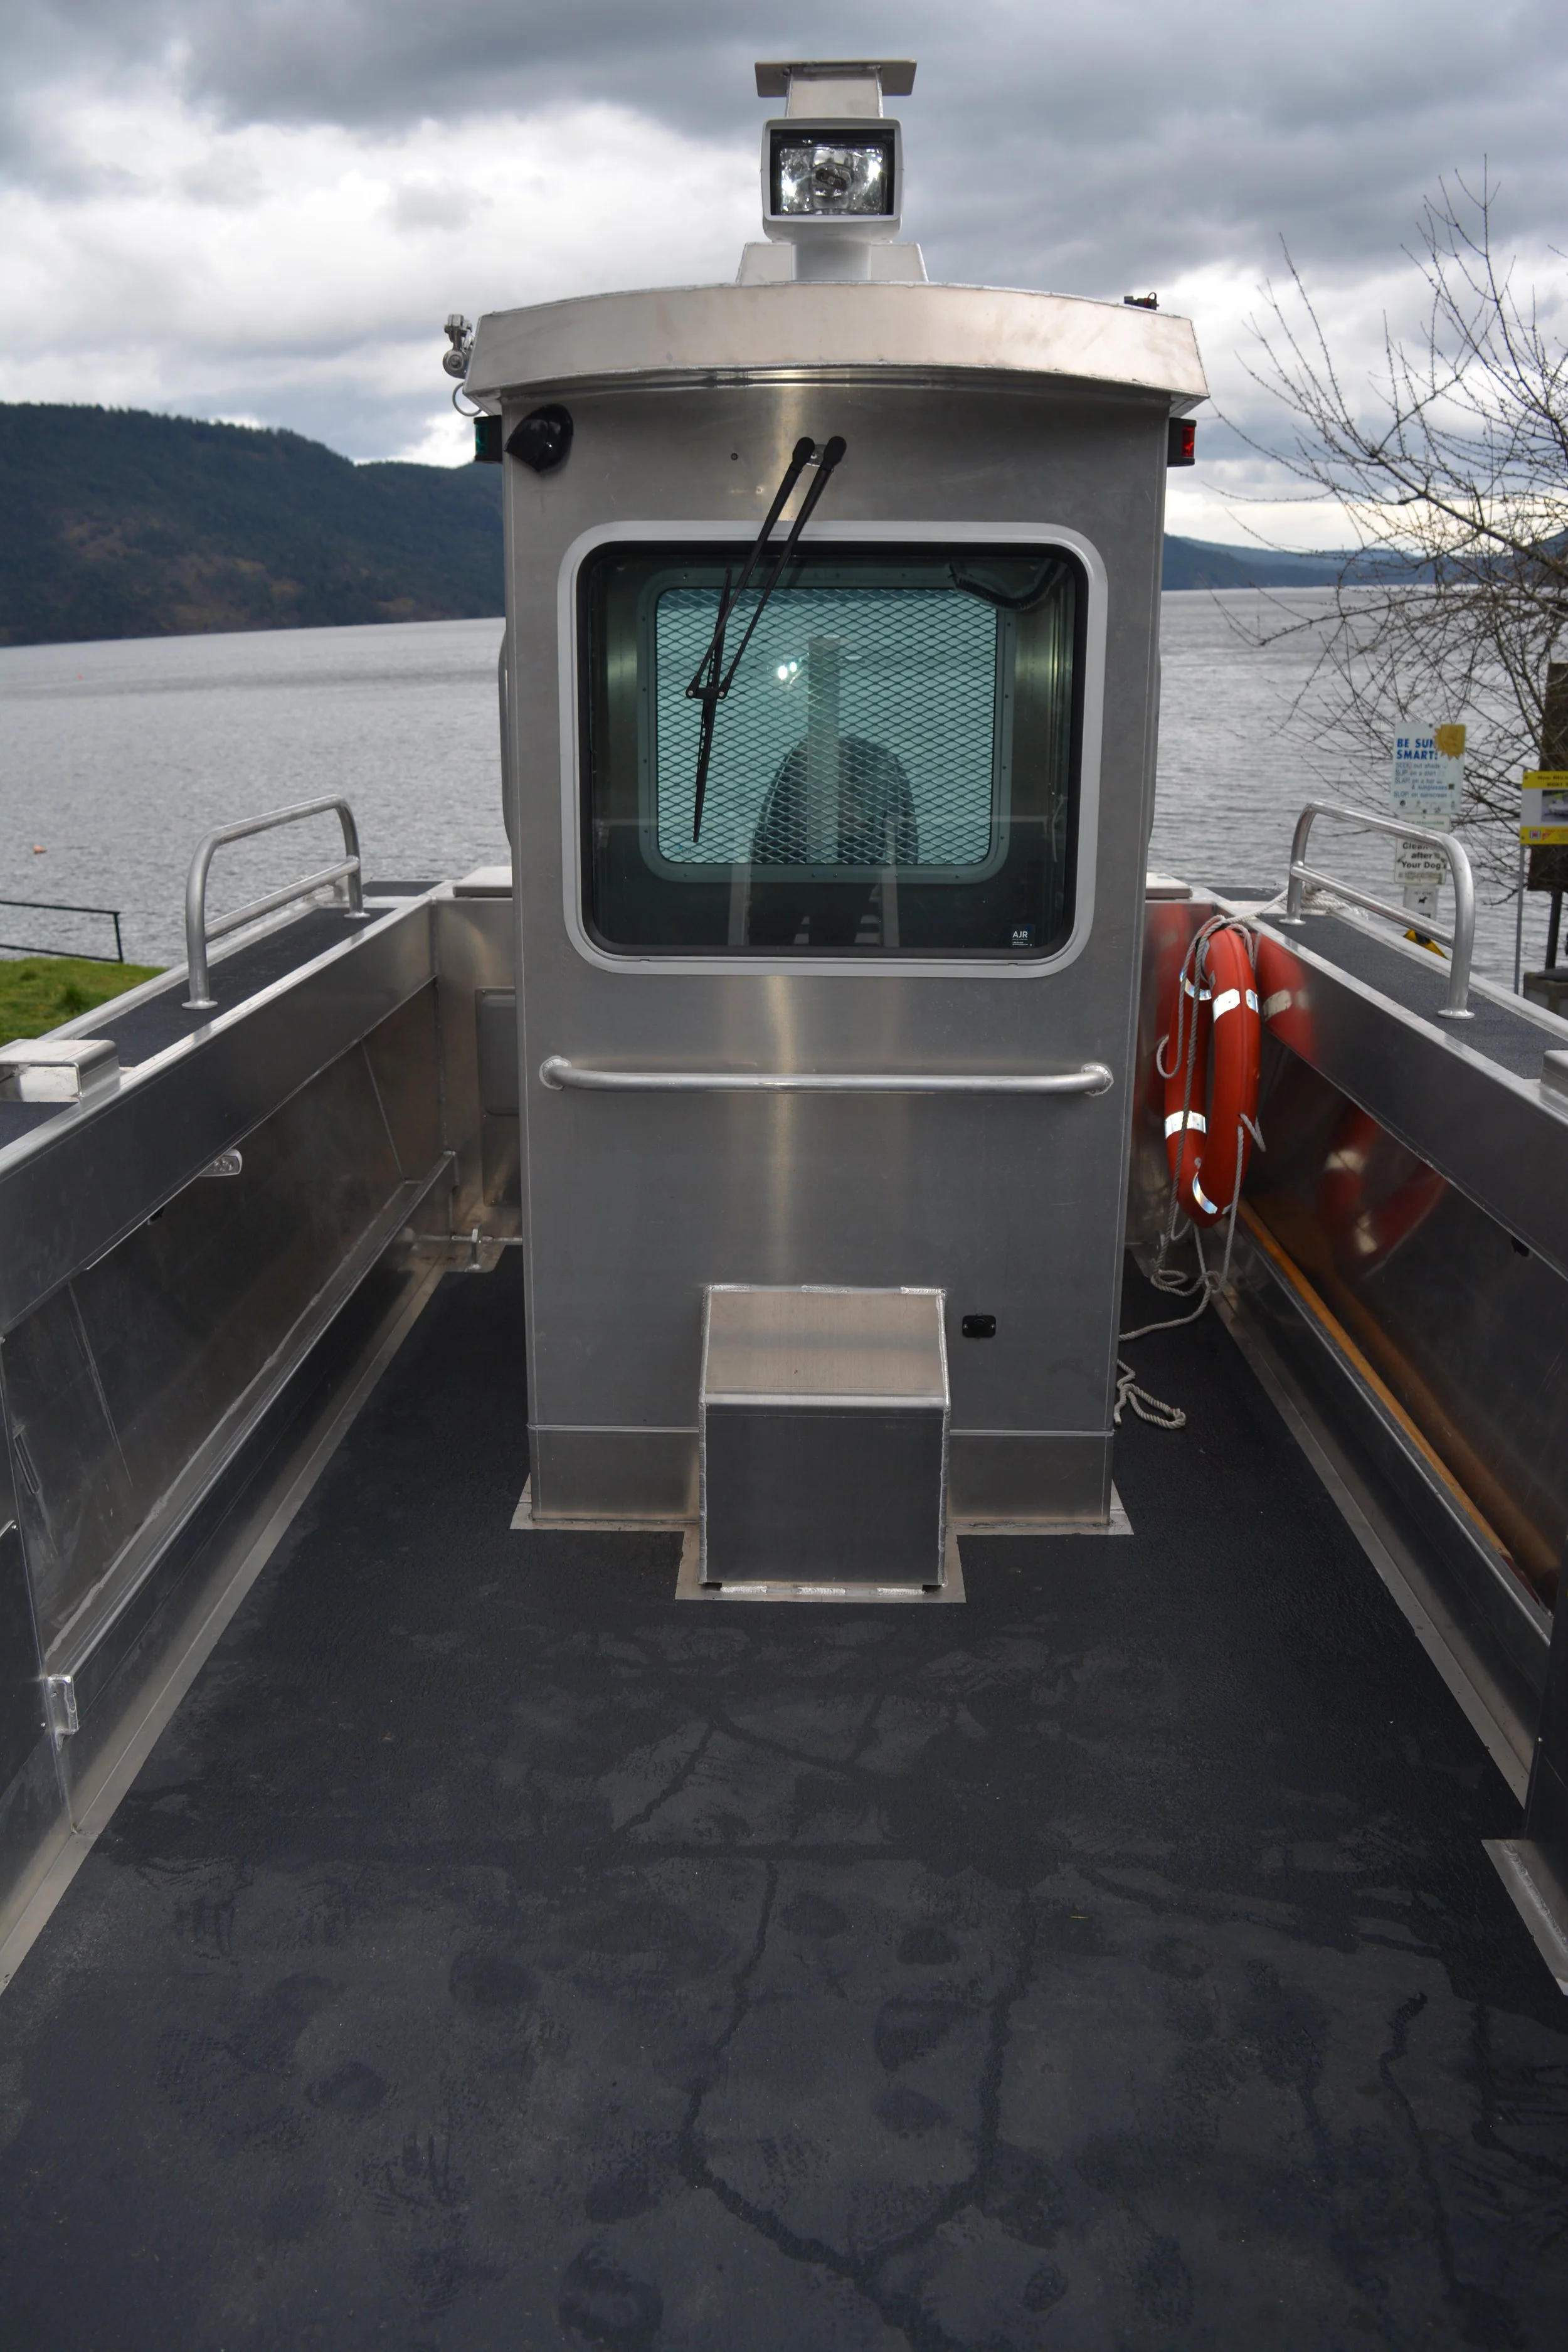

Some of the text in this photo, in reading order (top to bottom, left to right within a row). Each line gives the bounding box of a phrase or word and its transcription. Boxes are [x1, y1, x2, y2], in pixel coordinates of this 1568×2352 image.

[1397, 738, 1409, 748] BE
[1402, 861, 1441, 870] Your Dog
